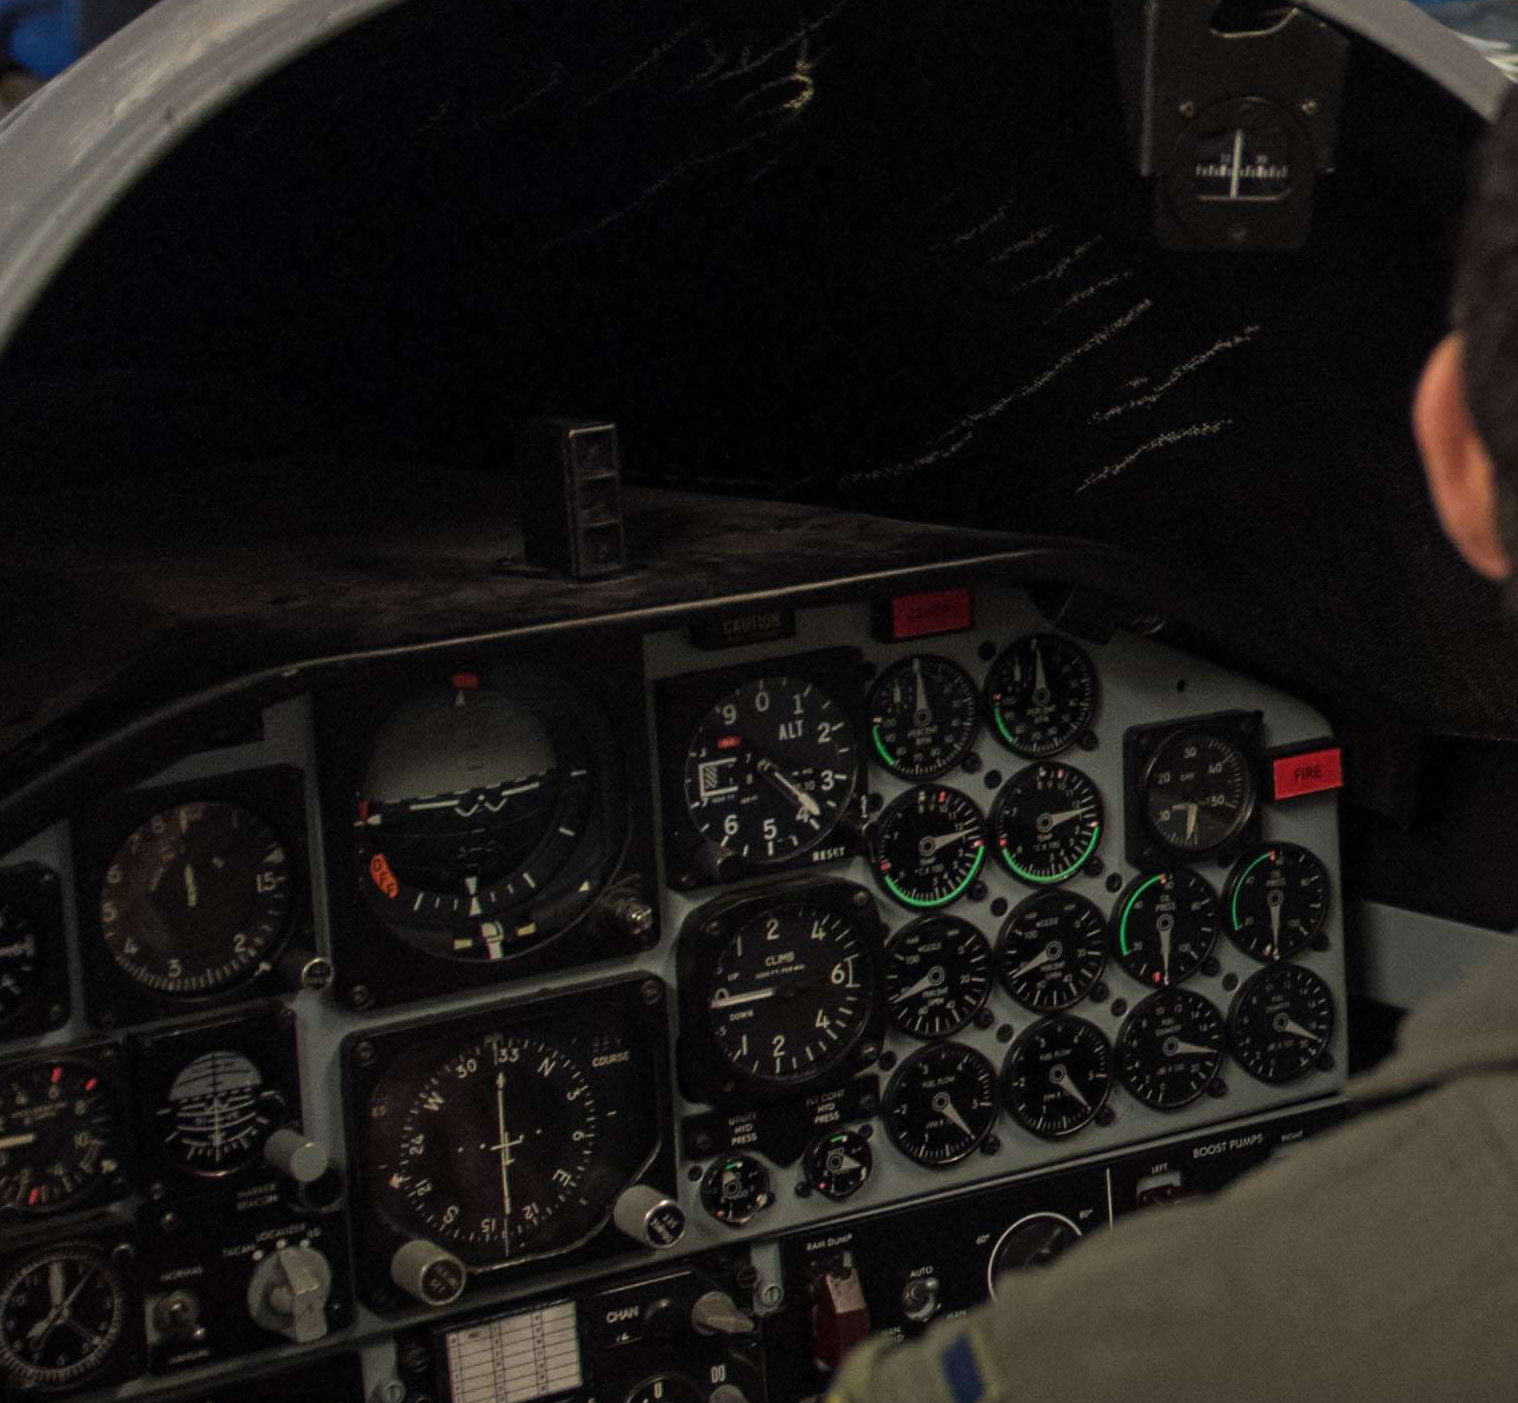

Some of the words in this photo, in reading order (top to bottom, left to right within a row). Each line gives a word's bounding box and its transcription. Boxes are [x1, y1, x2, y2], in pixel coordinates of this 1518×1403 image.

[755, 691, 770, 712] 0
[793, 694, 804, 715] 1
[722, 704, 737, 725] 9
[778, 719, 804, 741] ALT
[817, 722, 831, 743] 2
[820, 770, 835, 792] 3
[1294, 766, 1323, 782] FIRE
[724, 814, 739, 835] 6
[763, 819, 777, 840] 5
[813, 846, 846, 862] RESET
[106, 863, 123, 885] 6
[101, 901, 118, 924] 5
[766, 918, 780, 941] 2
[810, 920, 826, 941] 4
[123, 937, 139, 956] 4
[234, 933, 247, 954] 2
[168, 959, 182, 979] 3
[765, 950, 796, 967] CLIMB
[830, 962, 846, 985] 6
[729, 1009, 754, 1022] DOWN
[815, 1008, 832, 1029] 4
[498, 1049, 520, 1064] 33
[771, 1034, 786, 1058] 2
[454, 1057, 479, 1080] 30
[536, 1058, 557, 1079] N
[592, 1050, 631, 1069] COURSE
[422, 1091, 446, 1113] W
[816, 1101, 836, 1113] HYD
[813, 1110, 840, 1124] PRESS
[730, 1132, 758, 1146] PRESS
[733, 1123, 754, 1135] HYD
[408, 1133, 425, 1156] 24
[1193, 1141, 1227, 1160] BOOST
[1228, 1132, 1265, 1151] PUMPS
[551, 1167, 573, 1187] E
[1150, 1161, 1170, 1175] LEFT
[442, 1204, 460, 1225] S
[806, 1239, 828, 1252] RAM
[827, 1232, 853, 1247] DUMP
[909, 1265, 934, 1279] AUTO
[605, 1305, 640, 1325] CHAN
